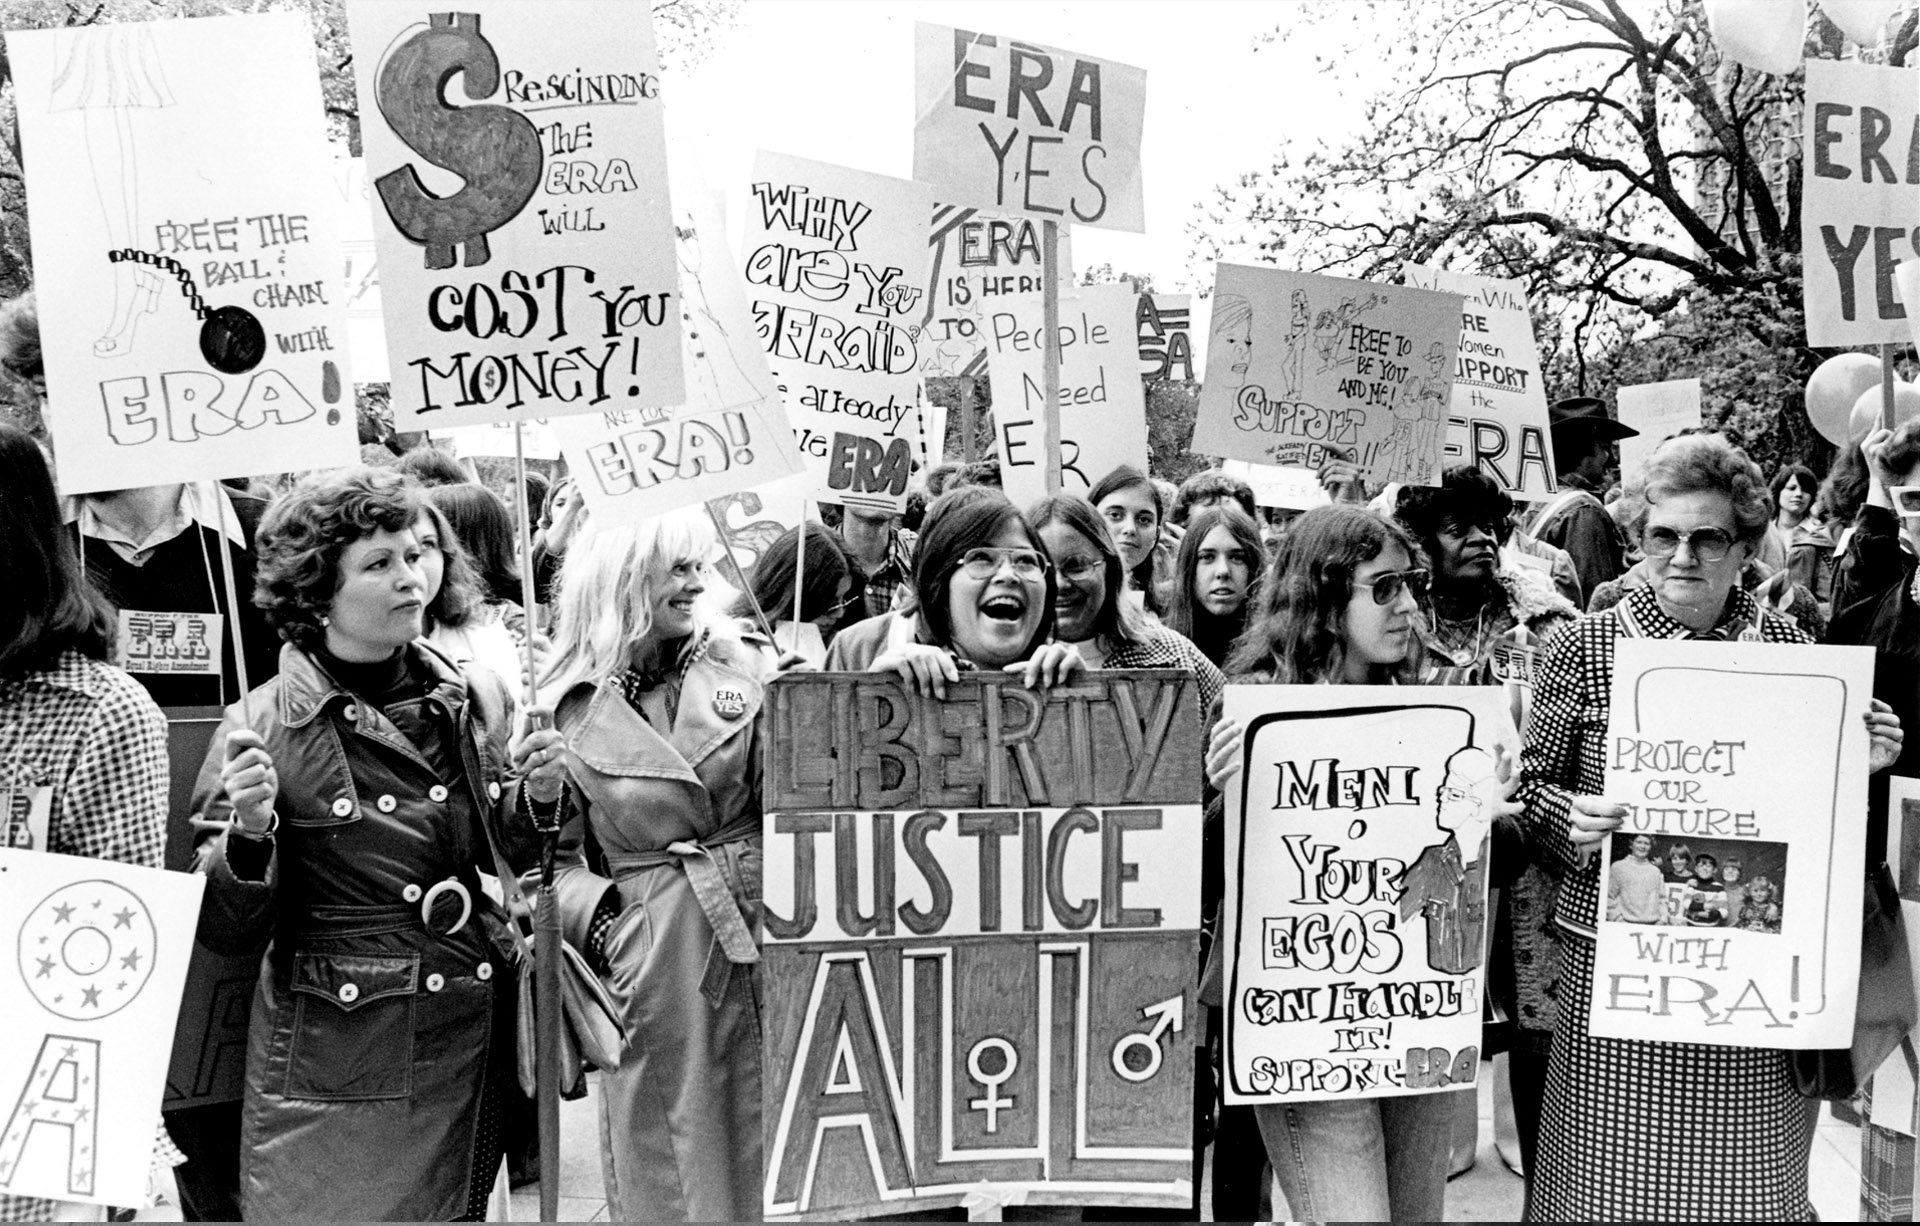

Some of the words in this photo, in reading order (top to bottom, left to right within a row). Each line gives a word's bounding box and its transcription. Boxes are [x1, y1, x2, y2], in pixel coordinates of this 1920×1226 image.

[954, 28, 1102, 142] ERA
[545, 159, 638, 195] ERA
[978, 122, 1107, 223] YES
[156, 216, 239, 254] FREE
[246, 214, 309, 248] THE
[752, 182, 872, 251] WHY
[959, 219, 1041, 267] ERA
[203, 259, 272, 288] BALL
[746, 243, 850, 302] are
[948, 275, 972, 306] IS
[1819, 225, 1920, 321] YE
[253, 281, 329, 309] CHAIN
[428, 265, 596, 341] COST
[589, 285, 671, 338] YOU
[1482, 288, 1524, 311] Who
[275, 326, 334, 354] WITH
[939, 318, 976, 340] TO
[1348, 323, 1391, 356] FREE
[1395, 335, 1413, 357] TO
[1461, 313, 1490, 333] RE
[1023, 365, 1107, 411] Need
[1337, 378, 1366, 399] AND
[1357, 356, 1375, 375] BE
[1379, 359, 1409, 384] YOU
[1454, 357, 1530, 389] UPPORT
[100, 360, 342, 446] ERA!
[1470, 390, 1497, 410] the
[585, 412, 754, 496] ERA!
[828, 431, 912, 497] ERA
[126, 617, 210, 660] ERA
[1742, 631, 1762, 642] ERA
[715, 701, 744, 714] YES
[716, 690, 744, 701] ERA
[771, 679, 1184, 808] LIBERTY
[1644, 779, 1708, 803] OUR
[1614, 802, 1761, 837] UTURE
[763, 807, 1165, 940] JUSTICE
[1281, 834, 1410, 905] YOUR
[1262, 910, 1404, 974] EGOS
[1606, 955, 1800, 1028] ERA!
[1329, 1021, 1392, 1053] IT!
[763, 942, 1193, 1217] ALL
